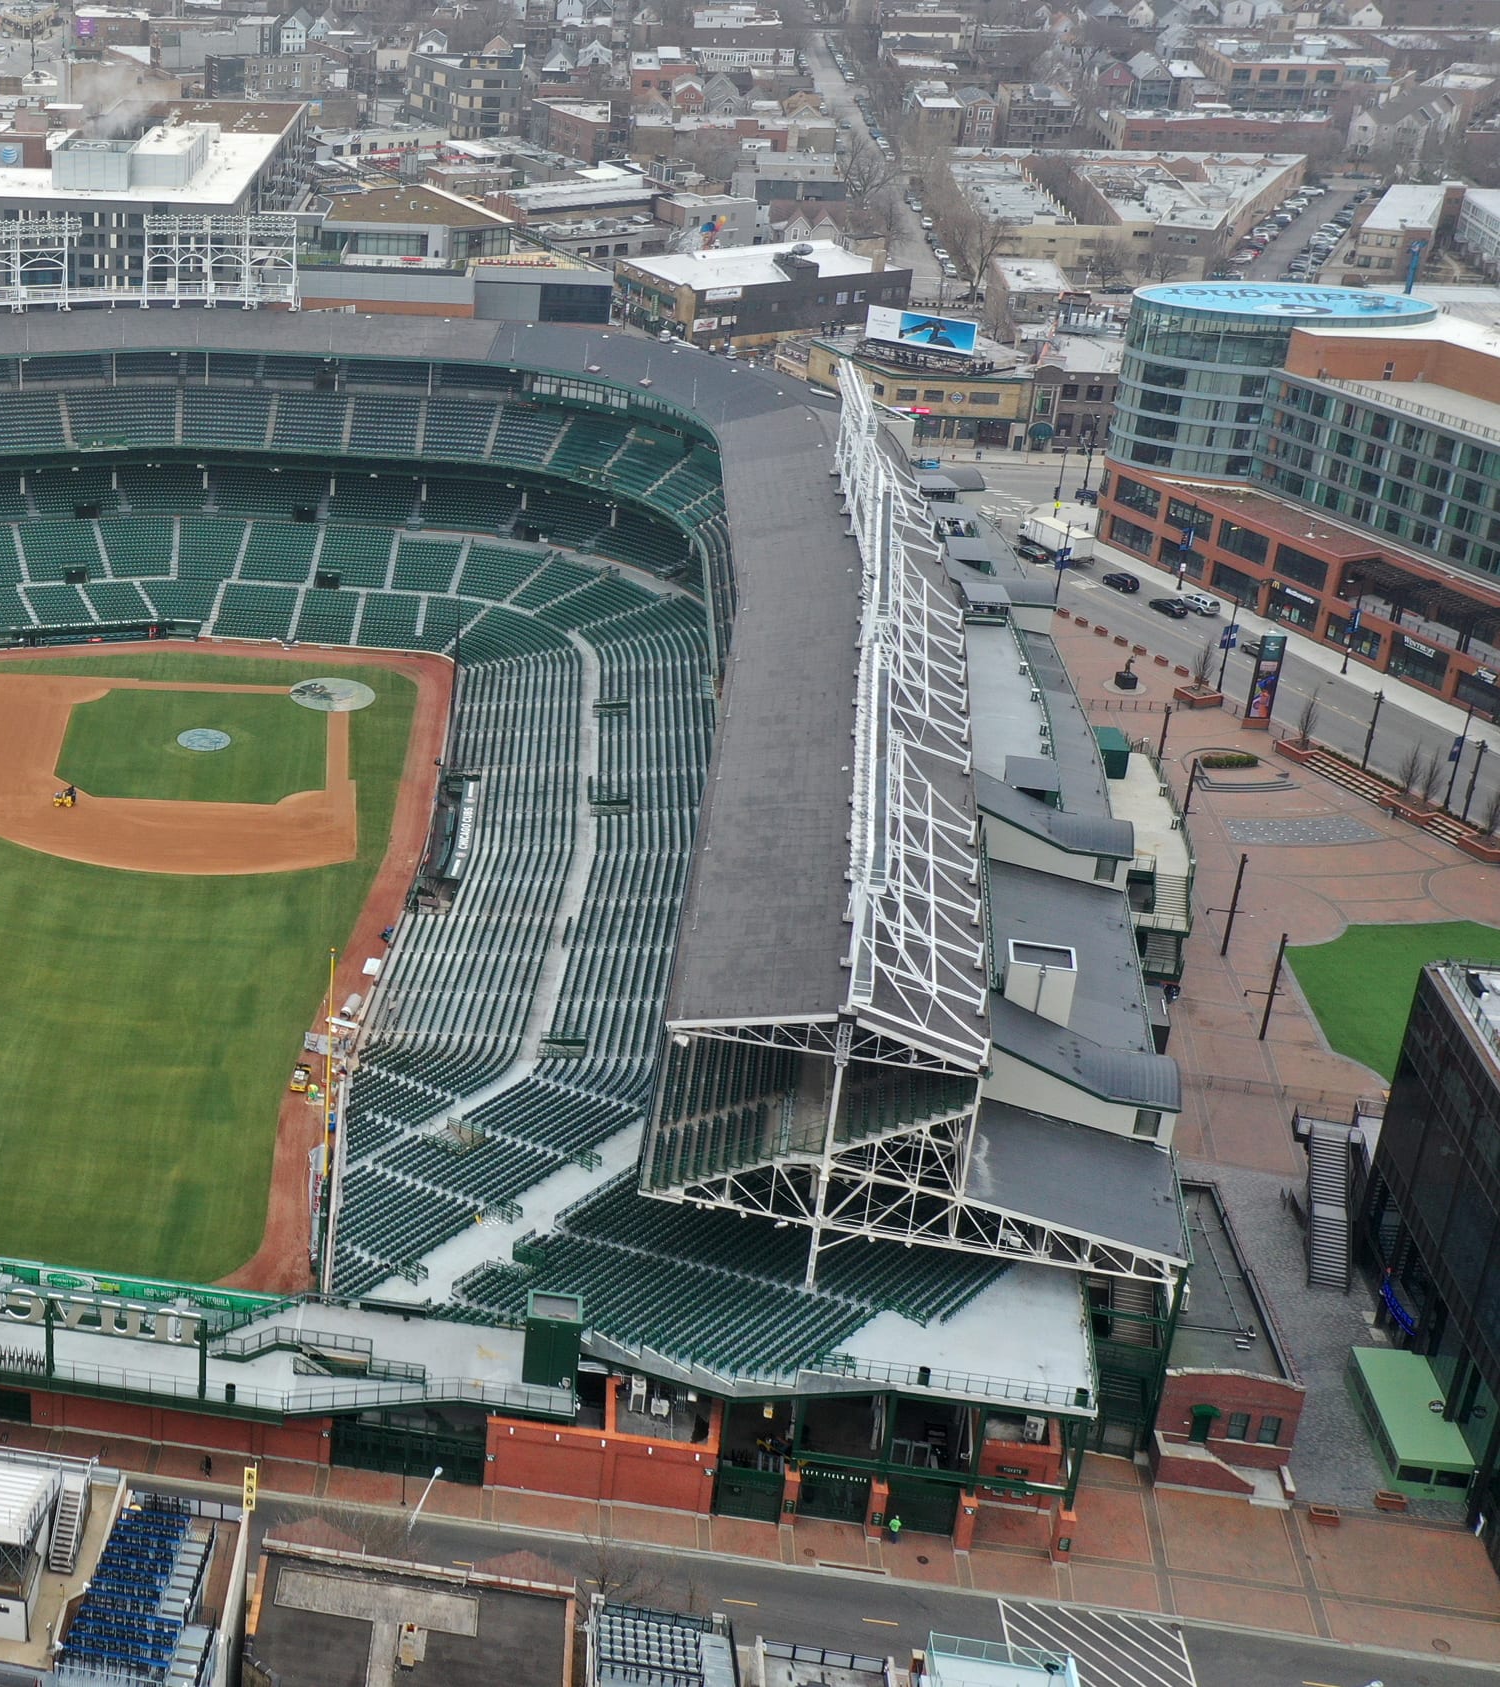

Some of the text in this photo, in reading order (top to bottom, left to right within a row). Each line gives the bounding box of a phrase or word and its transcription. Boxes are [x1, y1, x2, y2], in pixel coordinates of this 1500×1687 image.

[458, 807, 474, 850] CHICAGO CUBS
[206, 1294, 230, 1307] TEQUILA
[801, 1469, 819, 1477] LEFT
[823, 1472, 845, 1481] FIELD
